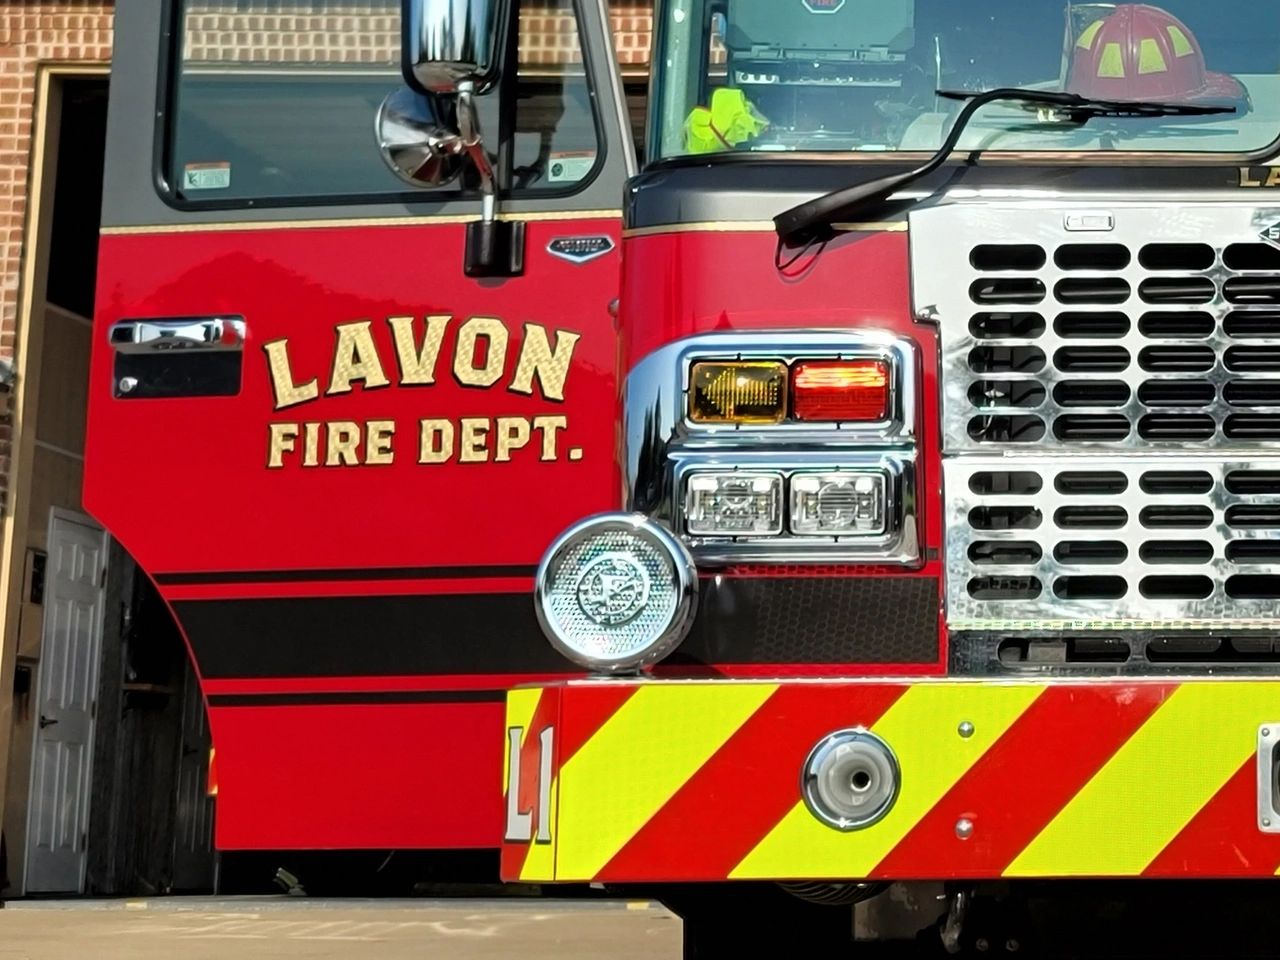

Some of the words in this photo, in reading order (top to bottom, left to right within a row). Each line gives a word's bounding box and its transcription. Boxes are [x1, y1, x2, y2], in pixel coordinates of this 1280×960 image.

[263, 314, 582, 411] LAVON
[267, 419, 396, 468] FIRE
[417, 414, 585, 466] DEPT.
